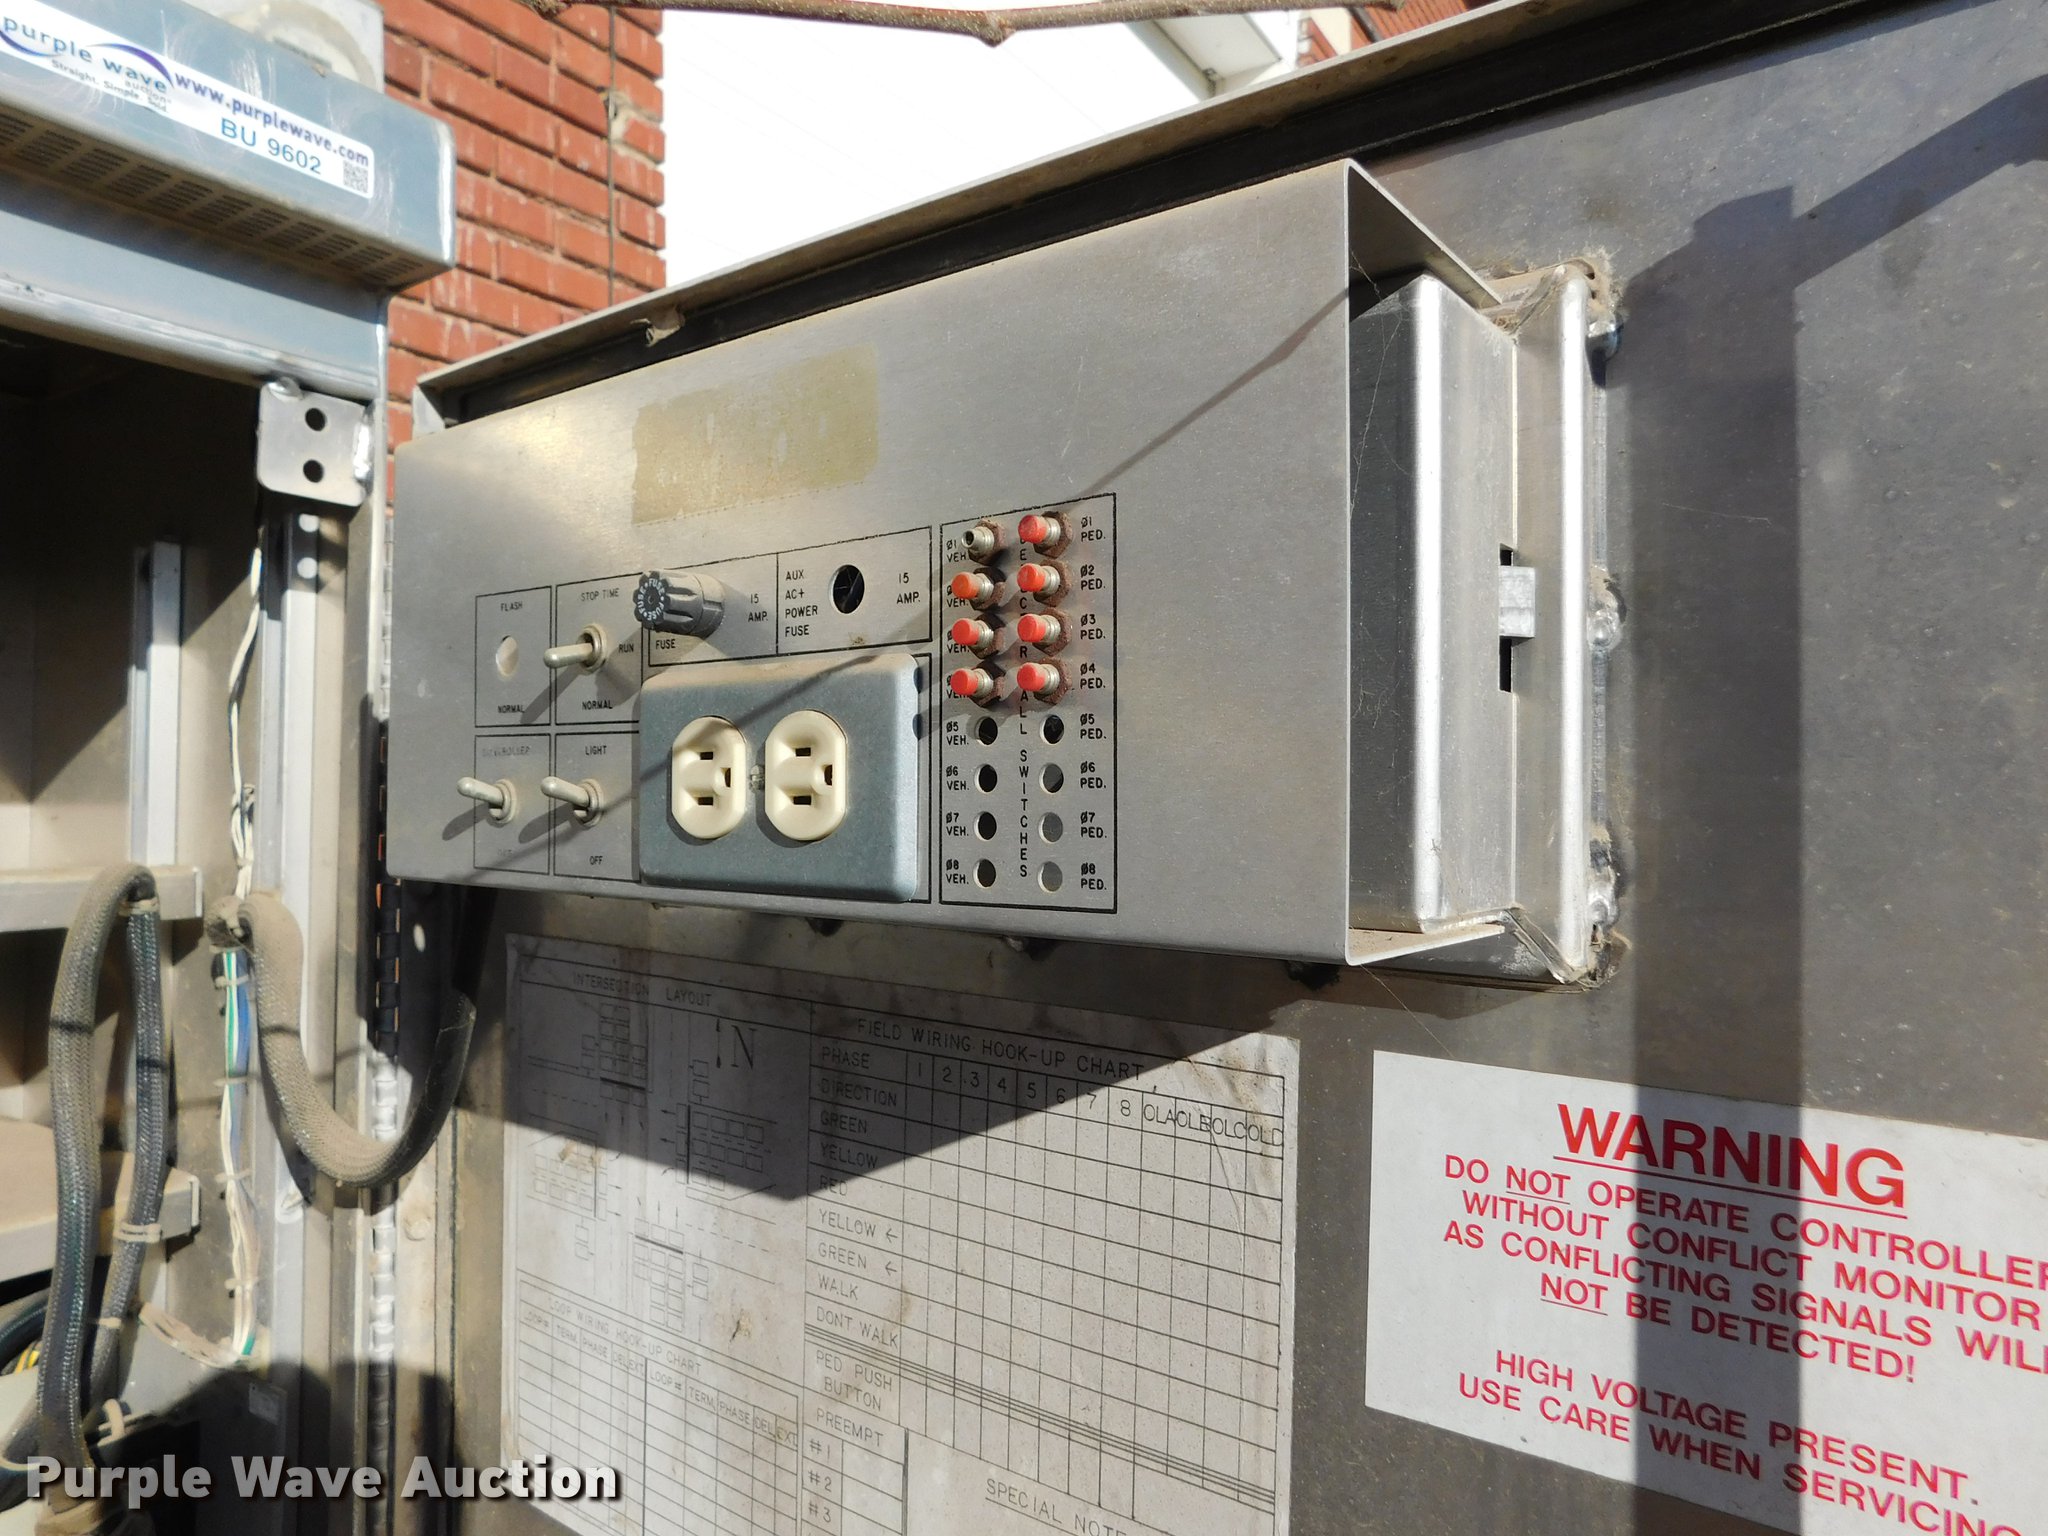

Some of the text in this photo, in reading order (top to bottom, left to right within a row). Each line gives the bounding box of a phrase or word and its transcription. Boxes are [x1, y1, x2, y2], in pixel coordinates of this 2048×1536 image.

[4, 16, 168, 93] purple wave
[175, 72, 369, 166] www.purplewave.com
[221, 118, 322, 175] BU 9602
[1081, 529, 1106, 541] PED.
[785, 569, 805, 581] AUX
[899, 572, 910, 584] 15
[1080, 579, 1106, 590] PED.
[580, 587, 620, 602] STOP TIME
[750, 593, 760, 604] 15
[785, 588, 805, 600] AC+
[896, 592, 921, 605] AMP.
[500, 601, 523, 612] FLASH
[785, 605, 818, 619] POWER
[748, 611, 769, 622] AMP.
[785, 625, 810, 637] FUSE
[1080, 628, 1106, 640] PED.
[618, 643, 635, 653] RUN
[655, 639, 676, 649] FUSE
[1080, 677, 1106, 689] PED.
[498, 704, 525, 714] NORMAL
[582, 699, 613, 711] NORMAL
[946, 735, 970, 746] VEH.
[1080, 728, 1107, 740] PED.
[585, 745, 607, 756] LIGHT
[946, 780, 970, 791] VEH.
[1080, 777, 1107, 789] PED.
[1019, 749, 1030, 878] SWITCHES
[946, 825, 969, 837] VEH.
[1080, 827, 1107, 839] PED.
[589, 855, 604, 866] OFF
[946, 873, 969, 885] VEH.
[1080, 878, 1107, 891] PED.
[572, 971, 713, 1008] INTERSECTION LAYOUT
[857, 1018, 1145, 1081] FIELD WIRING HOOK-UP CHART
[820, 1046, 870, 1070] PHASE
[942, 1067, 953, 1084] 2
[971, 1071, 980, 1088] 3
[997, 1077, 1008, 1094] 4
[1027, 1082, 1037, 1099] 5
[1056, 1088, 1066, 1104] 6
[1086, 1092, 1097, 1110] 7
[1120, 1099, 1131, 1117] 8
[820, 1078, 897, 1107] DIRECTION
[820, 1110, 868, 1134] GREEN
[820, 1141, 879, 1169] YELLOW
[1557, 1103, 1904, 1208] WARNING
[819, 1175, 848, 1197] RED
[1445, 1154, 1489, 1184] DO
[1506, 1165, 1571, 1198] NOT
[1588, 1180, 1749, 1234] OPERATE
[818, 1208, 877, 1238] YELLOW
[818, 1242, 867, 1270] GREEN
[1462, 1190, 2041, 1331] WITHOUT CONFLICT MONITOR
[817, 1273, 859, 1301] WALK
[1443, 1220, 2048, 1375] AS CONFLICTING SIGNALS WIL
[816, 1305, 899, 1349] DONT WALK
[1540, 1272, 1915, 1383] NOT BE DETECTED!
[666, 1350, 702, 1377] CHART
[816, 1349, 893, 1392] PED PUSH
[824, 1376, 882, 1412] BUTTON
[719, 1401, 751, 1426] PHASE
[816, 1407, 884, 1447] PREEMPT
[1459, 1372, 1522, 1412] USE
[1539, 1395, 1631, 1443] CARE
[1648, 1423, 1761, 1481] WHEN
[1496, 1349, 1979, 1506] HIGH VOLTAGE PRESENT.
[985, 1478, 1062, 1524] SPECIAL
